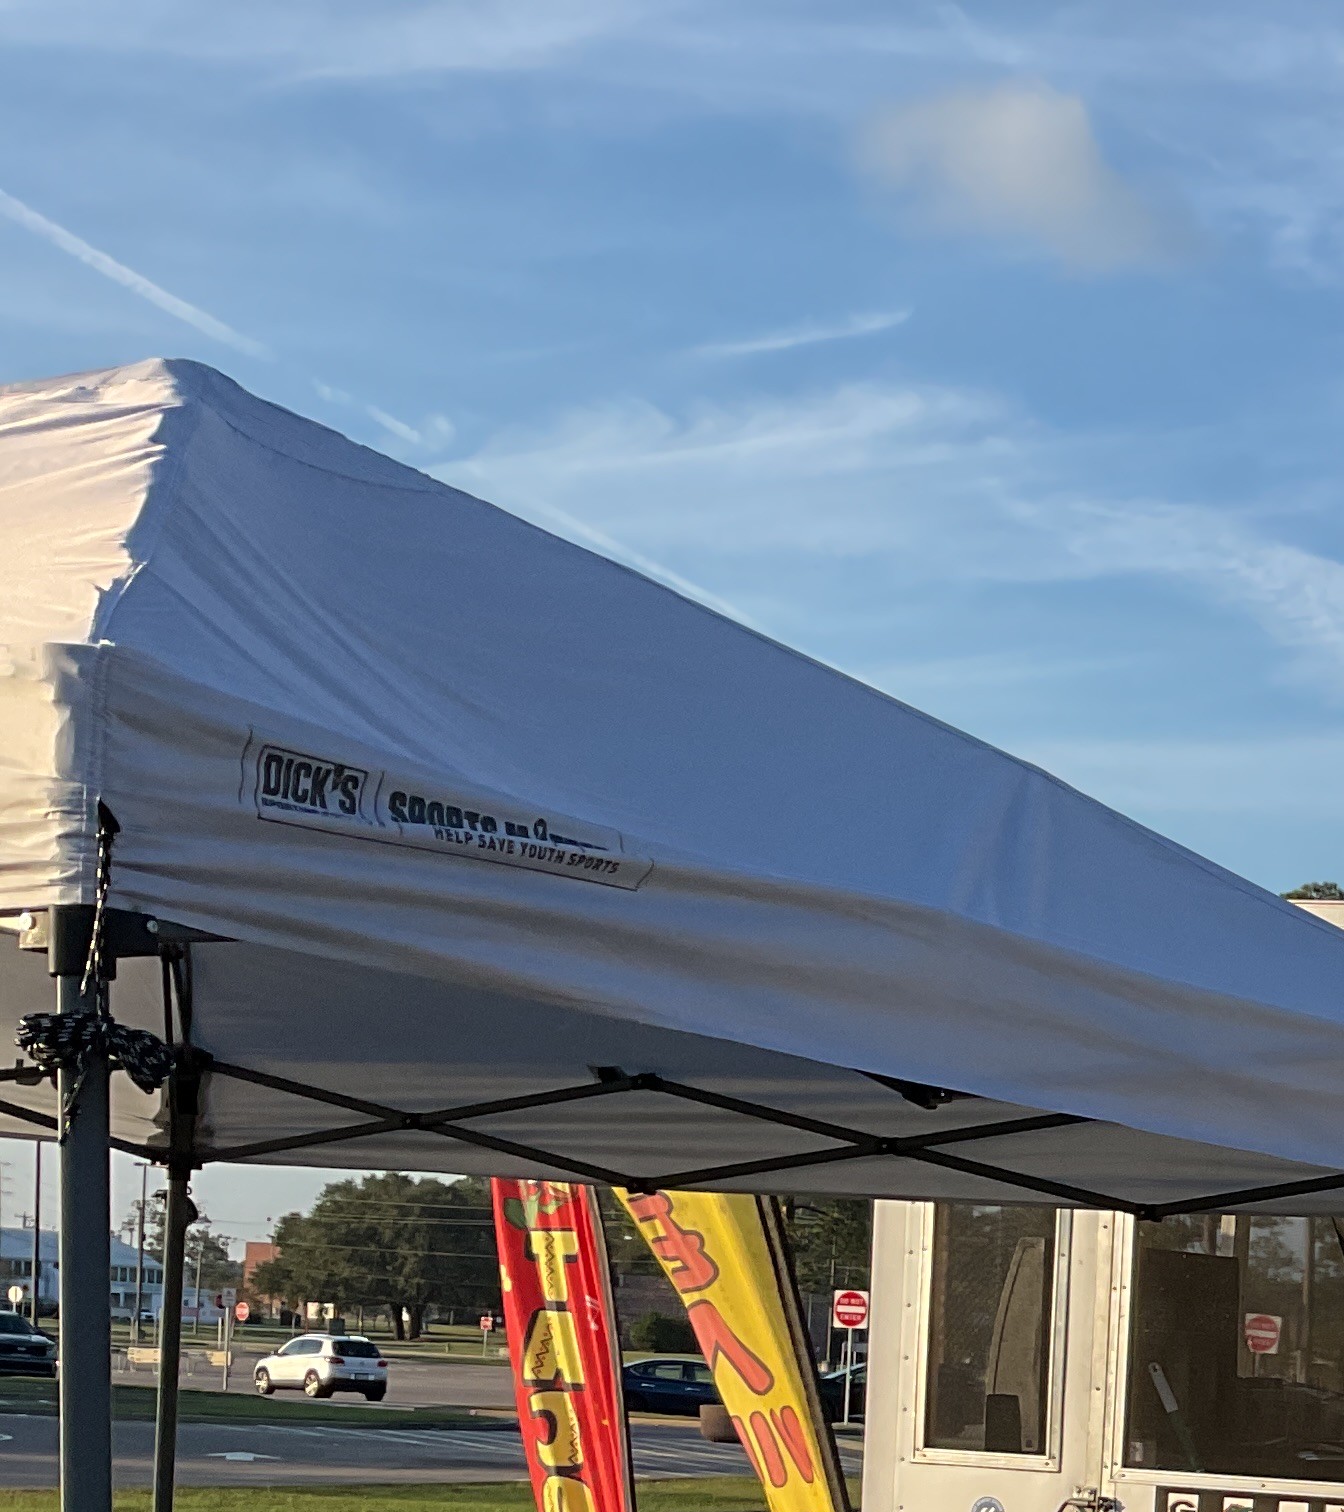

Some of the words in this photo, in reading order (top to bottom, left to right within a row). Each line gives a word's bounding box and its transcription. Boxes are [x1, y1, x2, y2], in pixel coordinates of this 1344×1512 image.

[262, 752, 361, 816] DICK'S
[433, 827, 473, 845] HELP
[477, 838, 515, 855] SAVE
[520, 841, 566, 865] YOUTH
[568, 852, 620, 874] SPORTS
